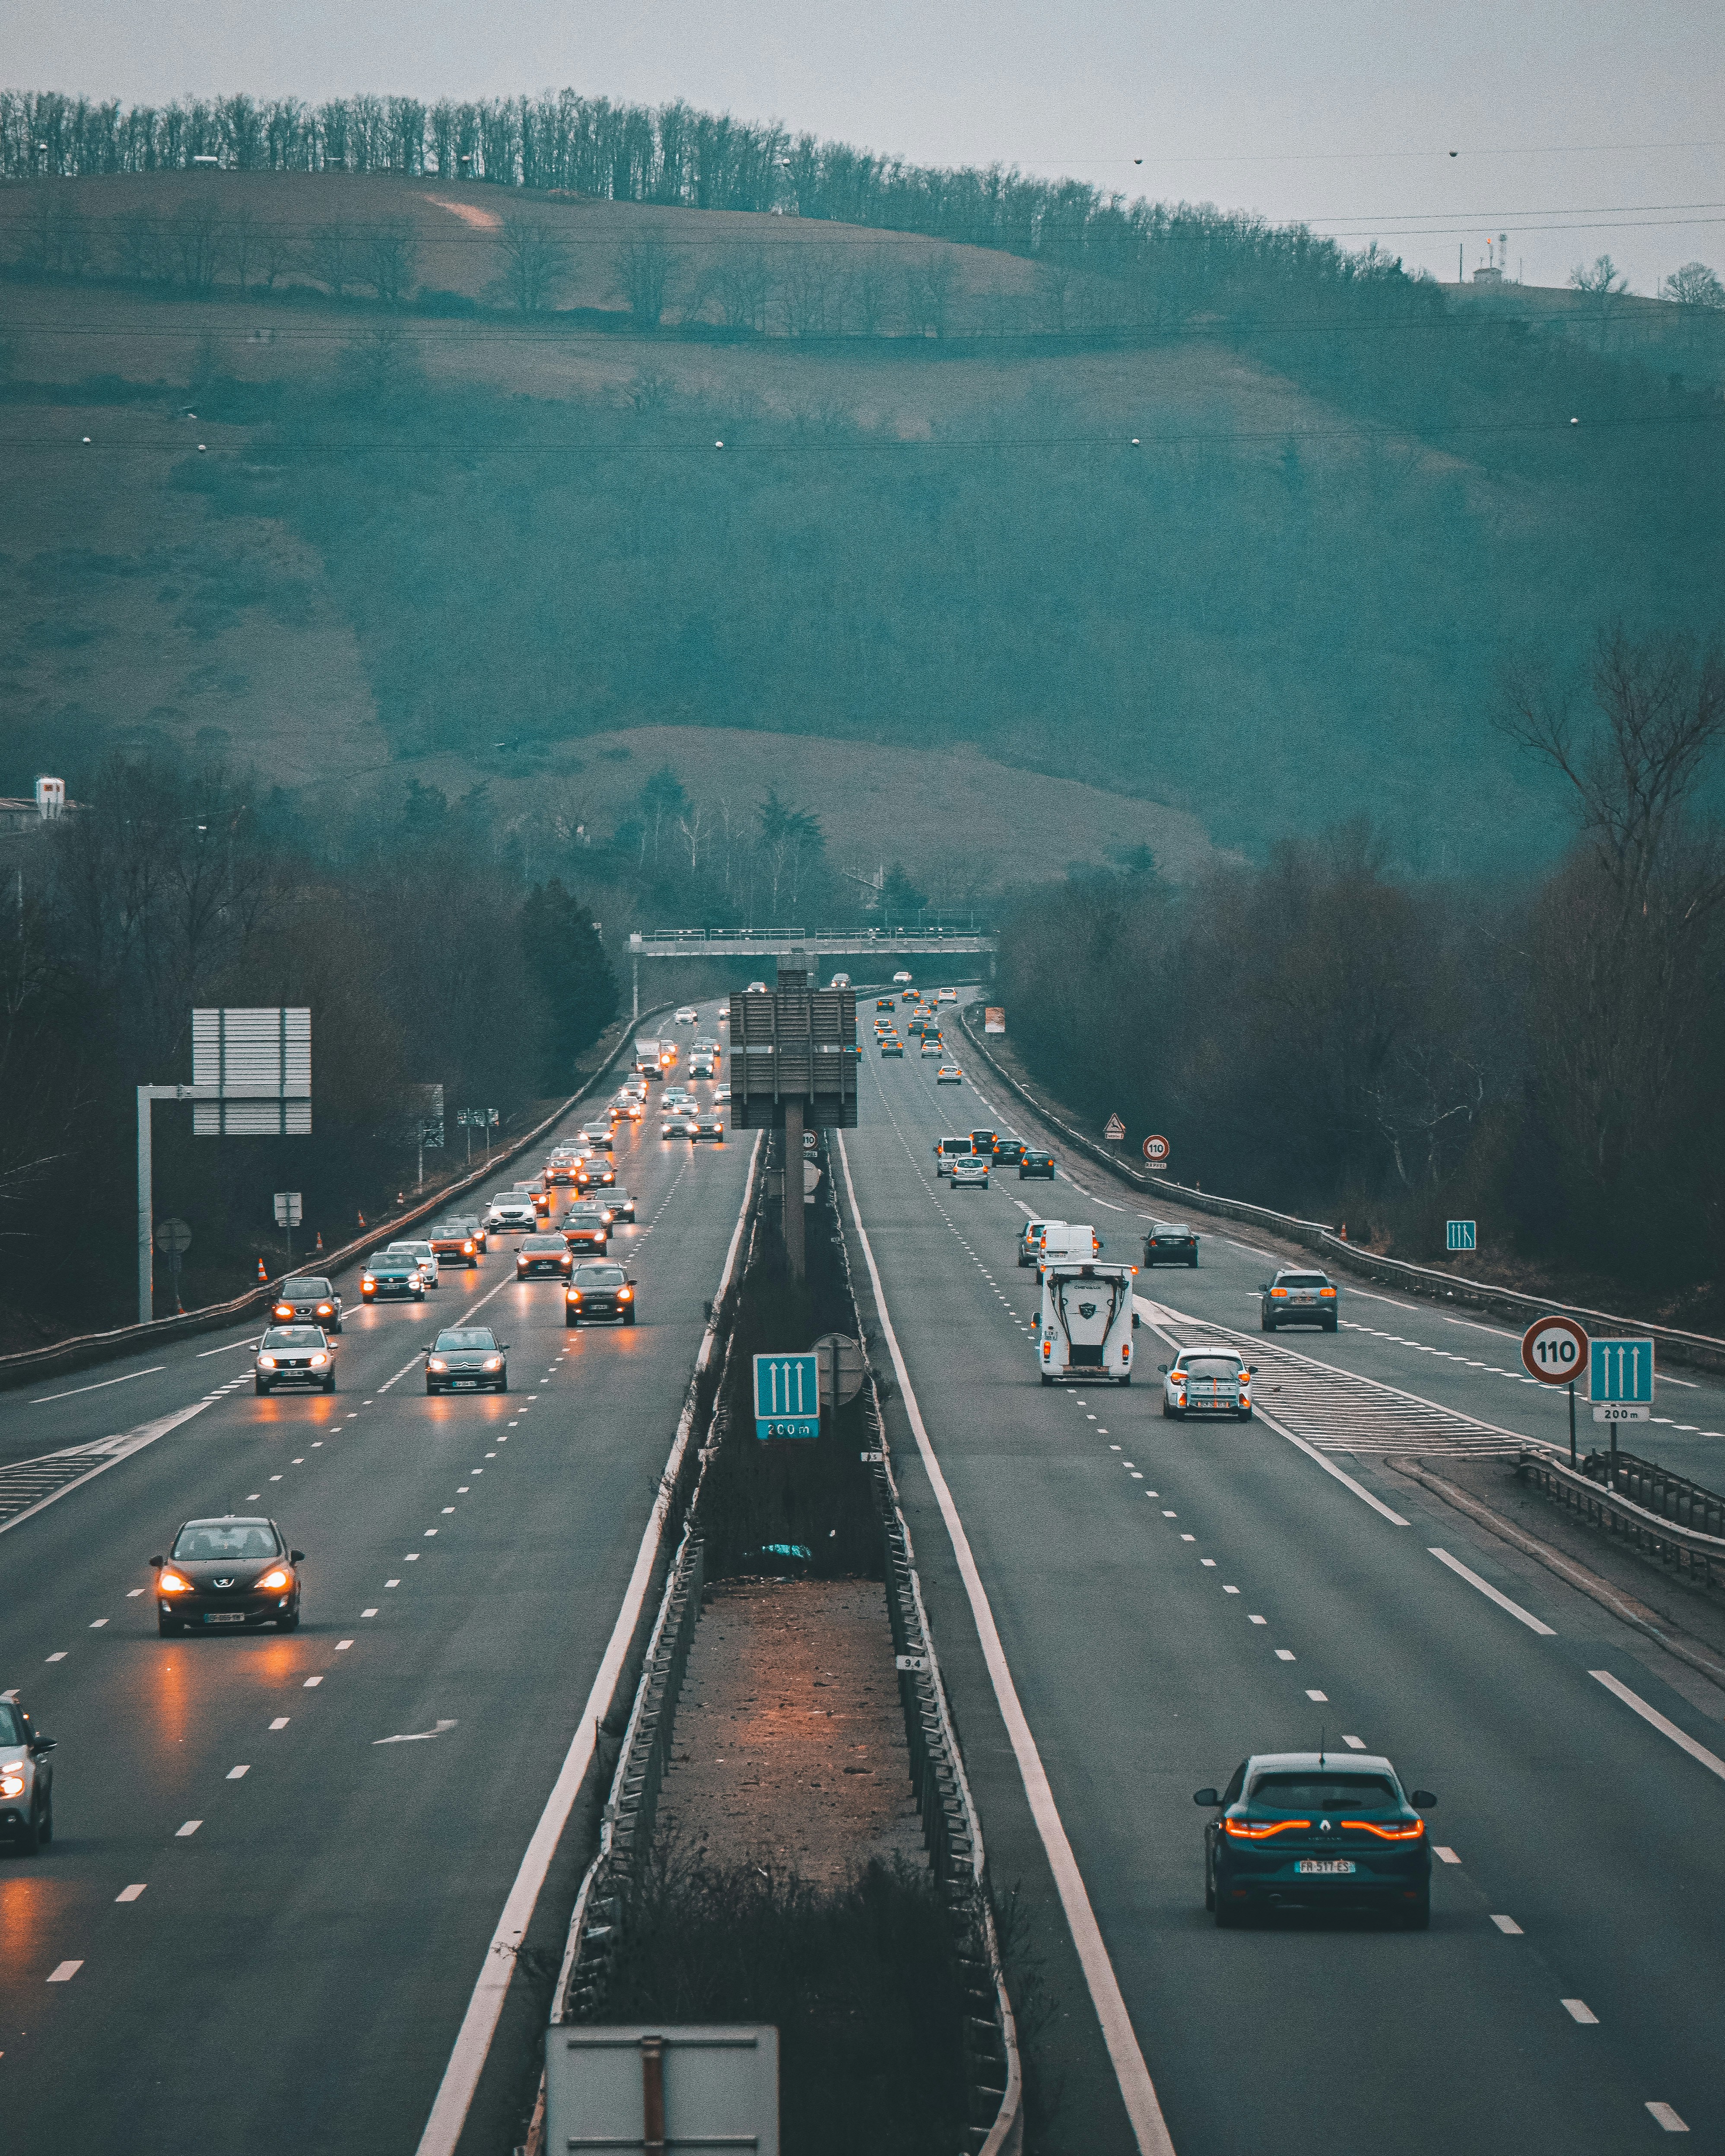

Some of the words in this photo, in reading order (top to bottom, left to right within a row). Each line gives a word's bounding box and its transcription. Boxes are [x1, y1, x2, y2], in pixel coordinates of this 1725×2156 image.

[1149, 1144, 1163, 1153] 110
[1537, 1340, 1575, 1362] 110
[1604, 1410, 1628, 1419] 200
[768, 1424, 795, 1435] 200
[799, 1426, 810, 1434] m
[1337, 1862, 1349, 1871] ES
